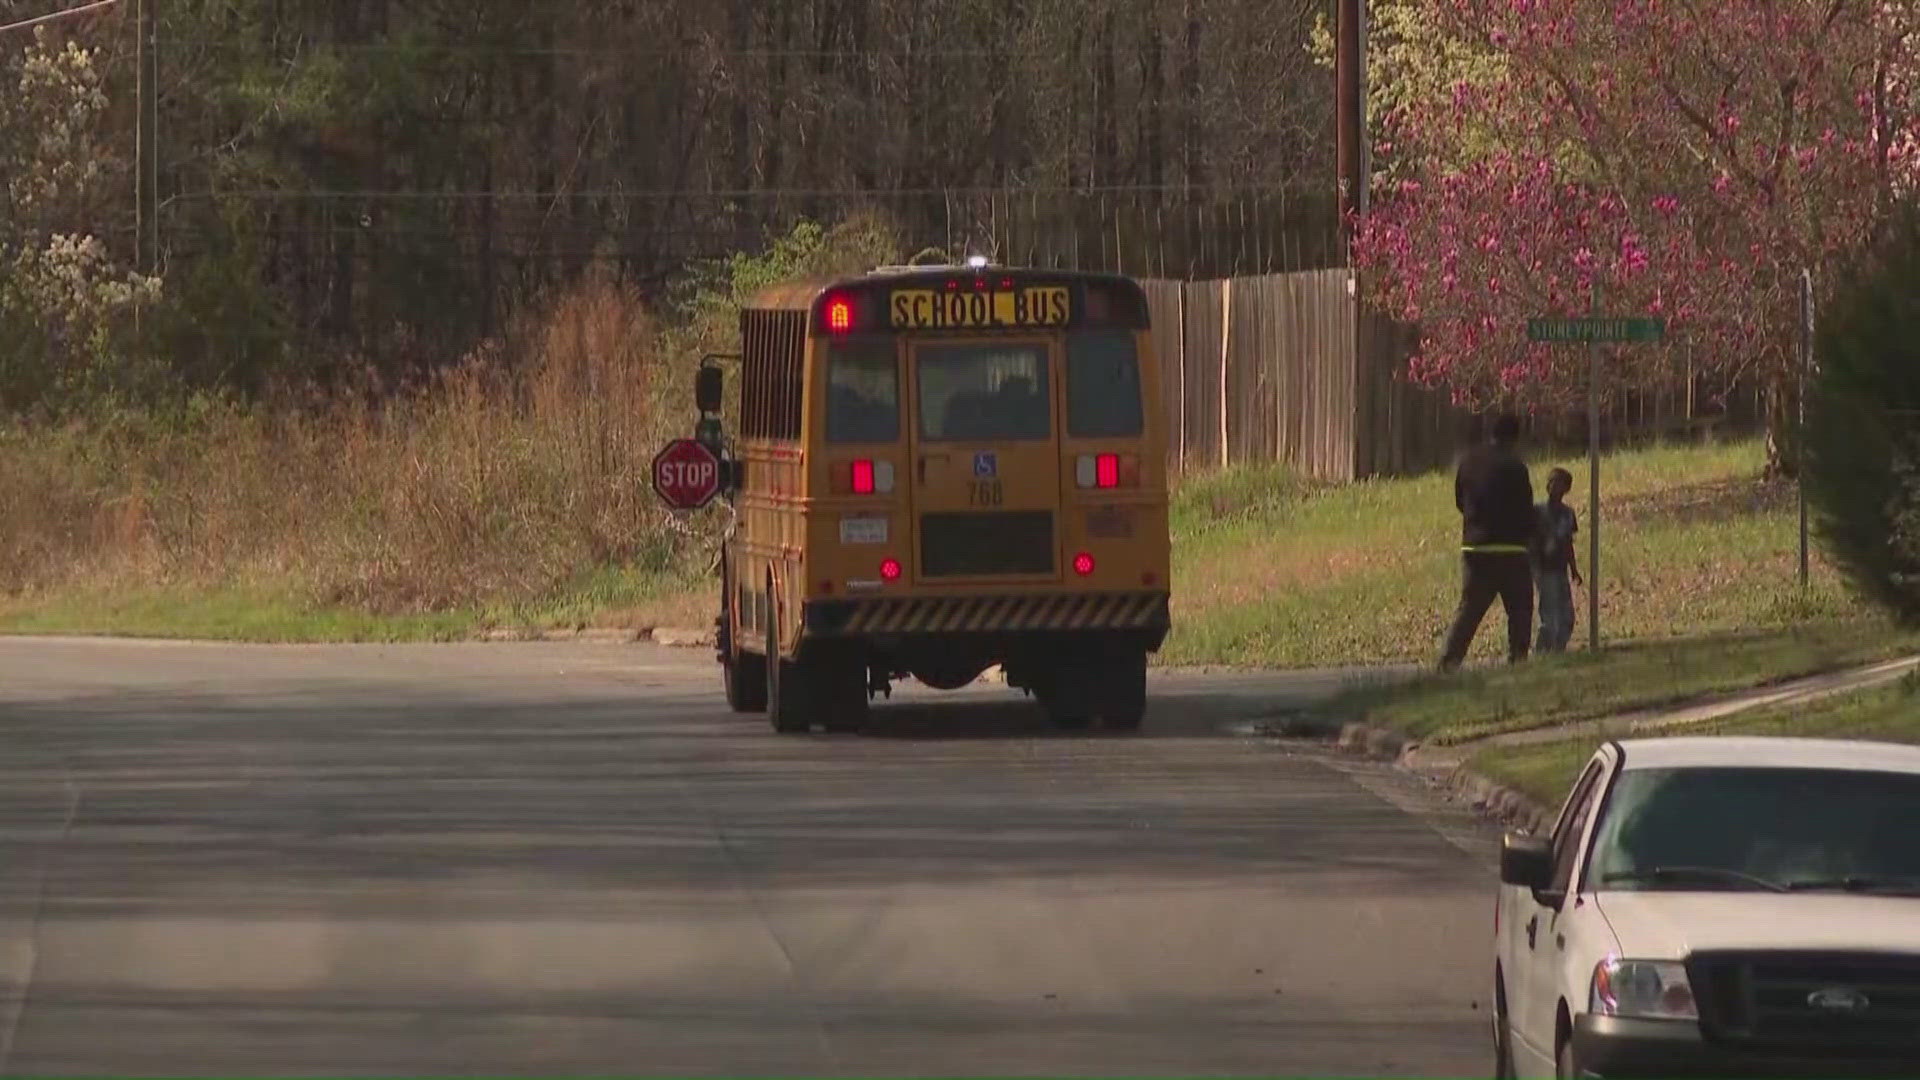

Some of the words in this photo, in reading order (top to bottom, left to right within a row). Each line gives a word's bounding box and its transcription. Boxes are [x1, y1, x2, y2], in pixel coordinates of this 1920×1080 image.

[894, 292, 1003, 327] SCHOOL
[1014, 290, 1067, 323] BUS
[661, 462, 713, 487] STOP
